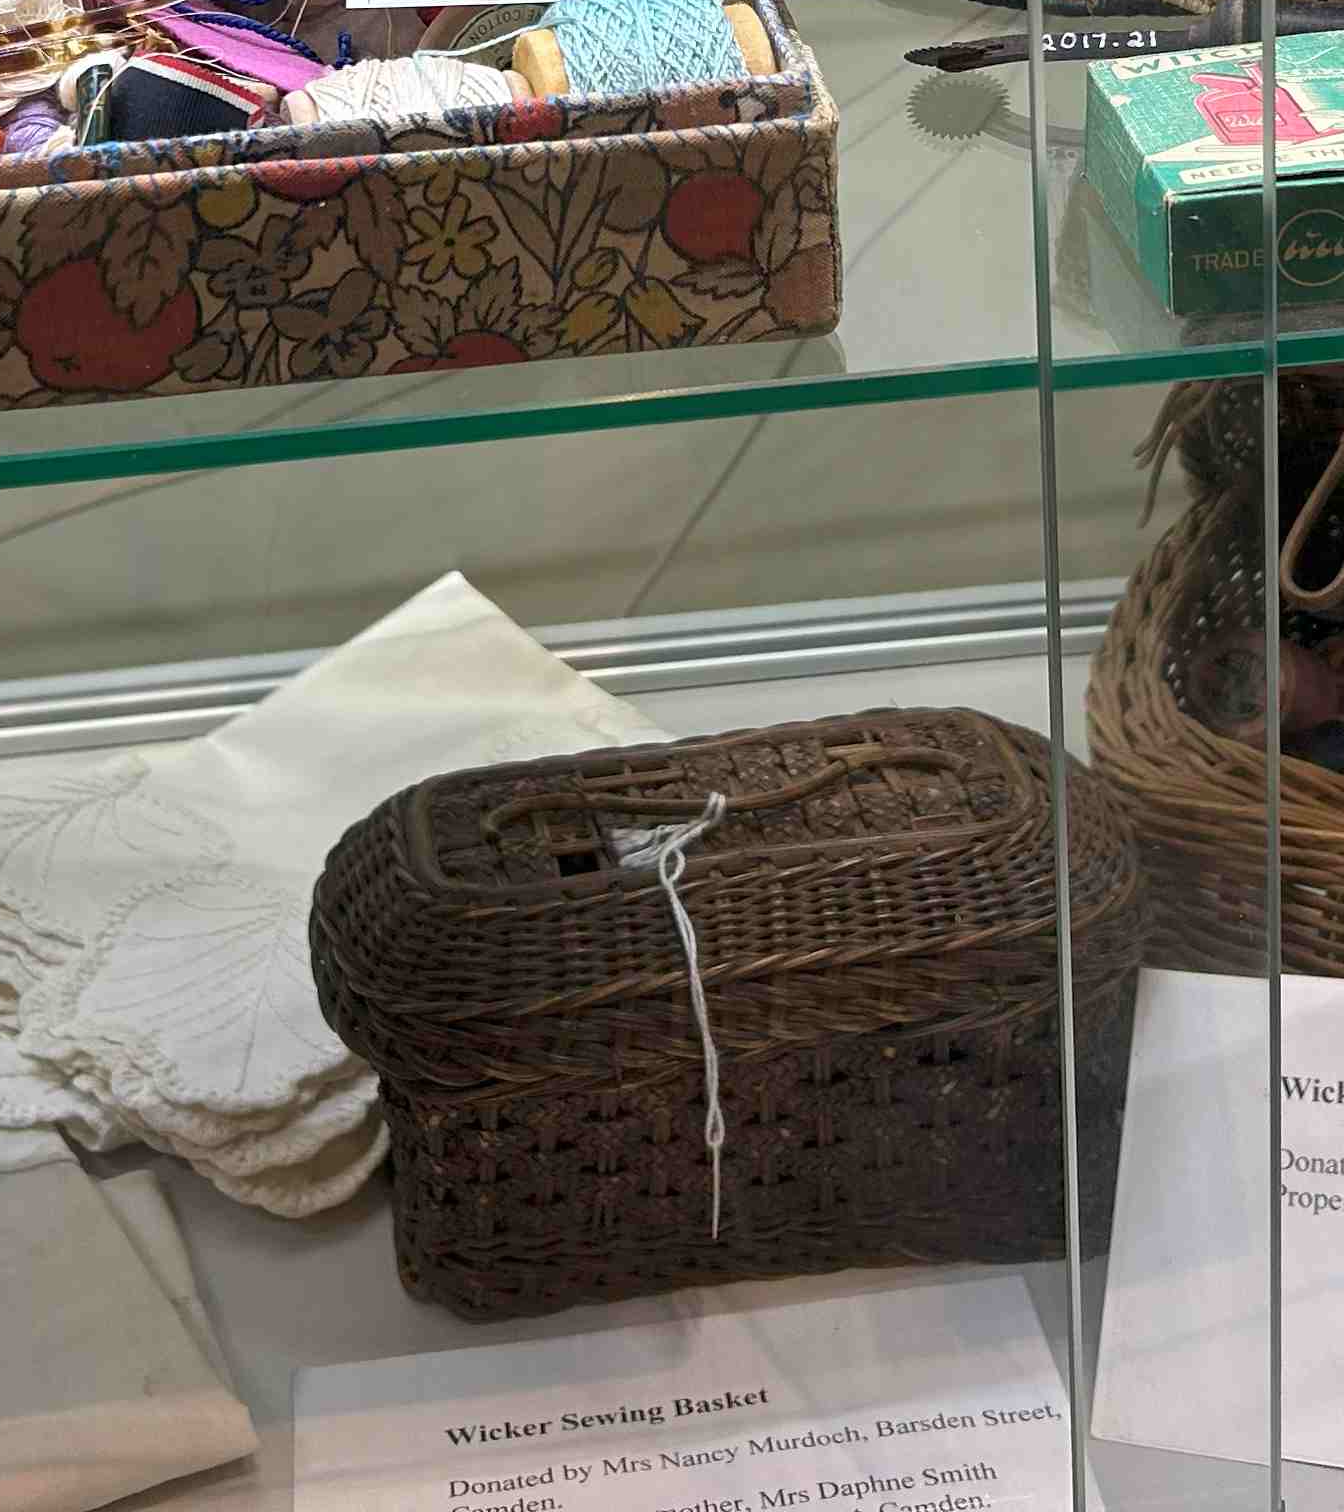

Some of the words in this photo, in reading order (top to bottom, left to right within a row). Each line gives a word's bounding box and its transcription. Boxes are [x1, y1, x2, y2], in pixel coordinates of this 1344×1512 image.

[1041, 30, 1158, 52] 2017.21
[1191, 249, 1265, 273] TRADE
[446, 1418, 553, 1448] Wicker
[561, 1401, 665, 1433] Sewing
[674, 1387, 770, 1417] Basket
[449, 1468, 554, 1497] Donated
[564, 1464, 592, 1483] by
[603, 1456, 652, 1476] Mrs
[660, 1446, 739, 1470] Nancy
[748, 1423, 869, 1458] Murdoch,
[876, 1409, 975, 1439] Barsden
[982, 1400, 1063, 1428] Street,
[759, 1489, 810, 1510] Mrs
[817, 1474, 915, 1501] Daphne
[922, 1461, 999, 1488] Smith
